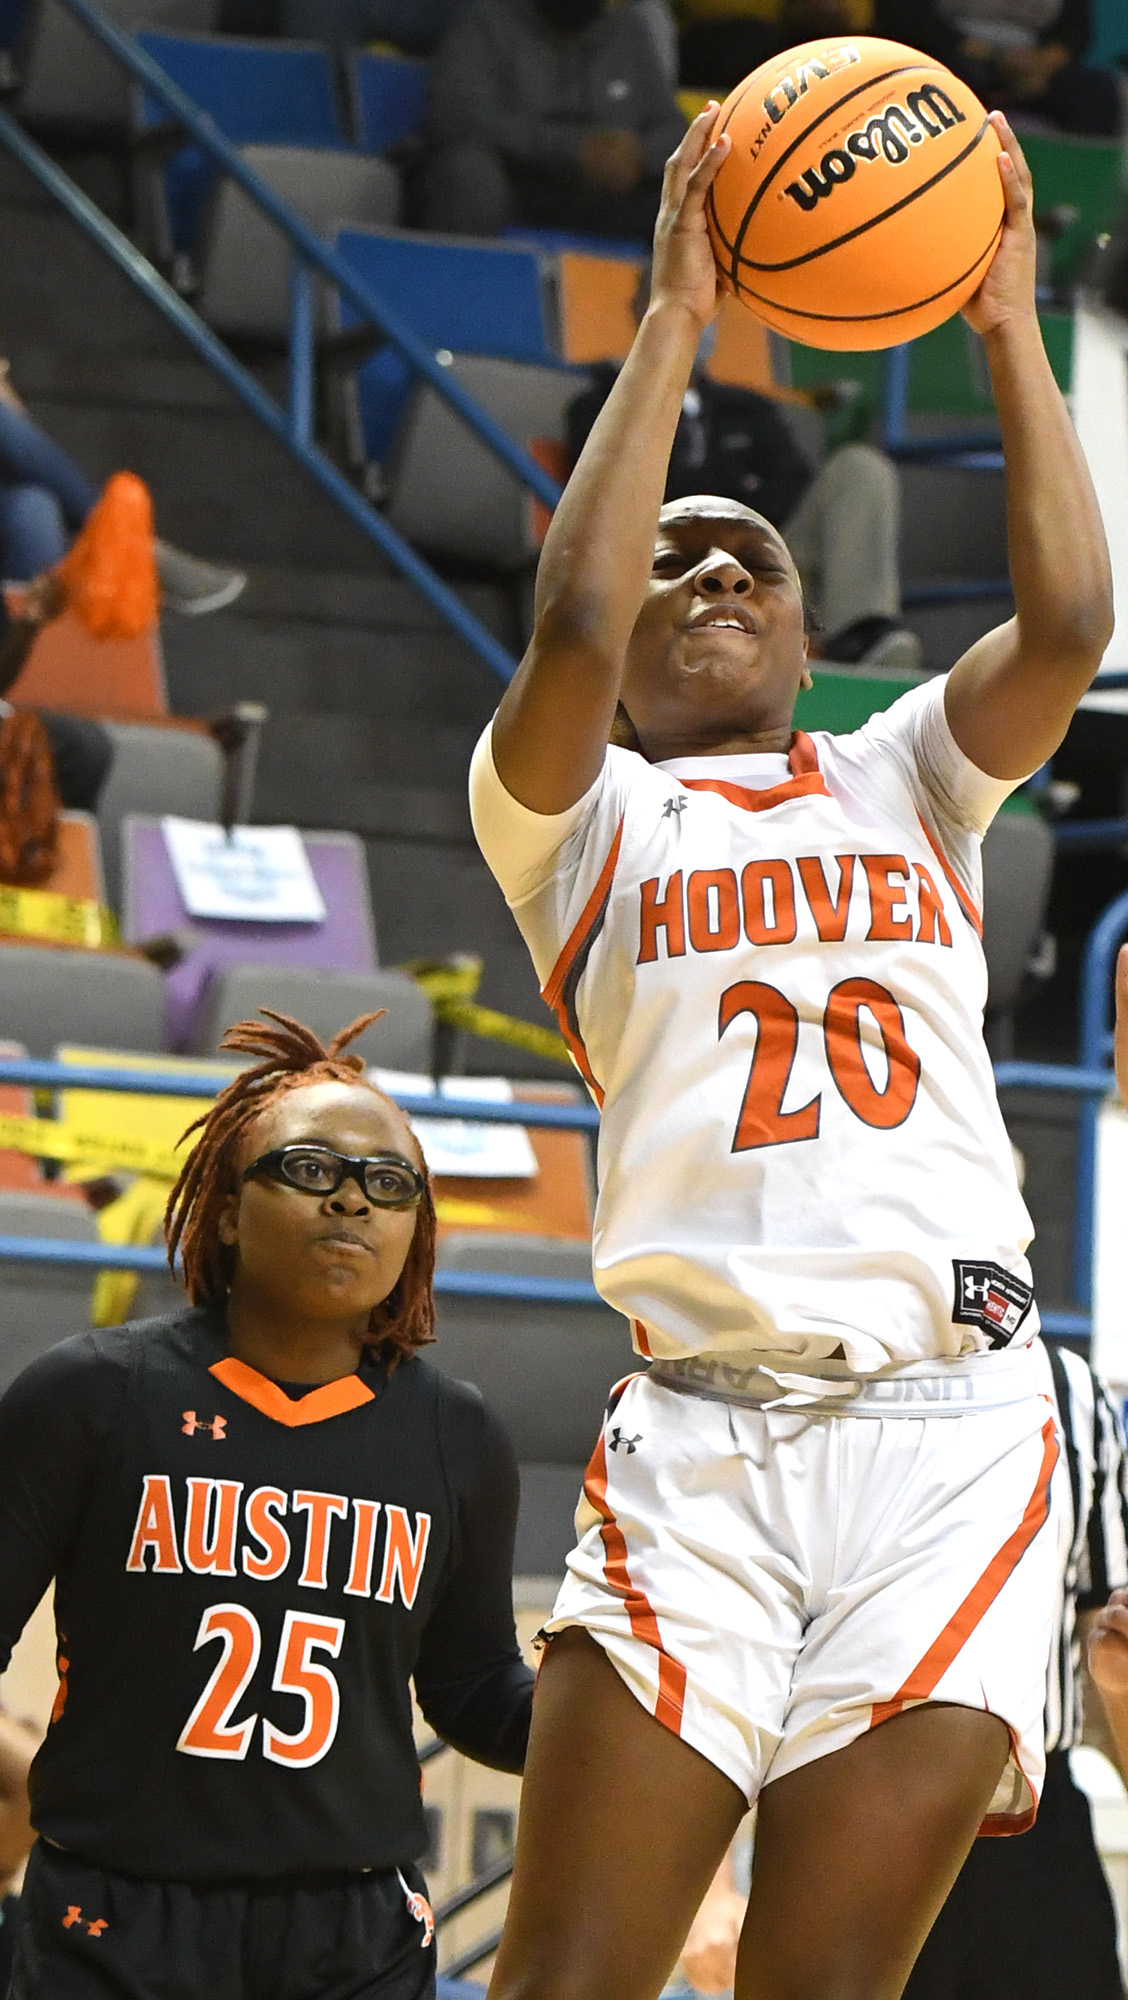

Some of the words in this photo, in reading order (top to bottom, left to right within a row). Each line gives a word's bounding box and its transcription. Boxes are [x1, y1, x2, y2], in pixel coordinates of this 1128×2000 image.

[750, 125, 773, 162] NXT
[763, 44, 861, 124] EVO
[784, 83, 967, 211] Wilson
[636, 854, 953, 966] HOOVER
[718, 976, 921, 1154] 20
[864, 1376, 974, 1402] UND
[125, 1474, 431, 1610] AUSTIN
[176, 1602, 345, 1768] 25
